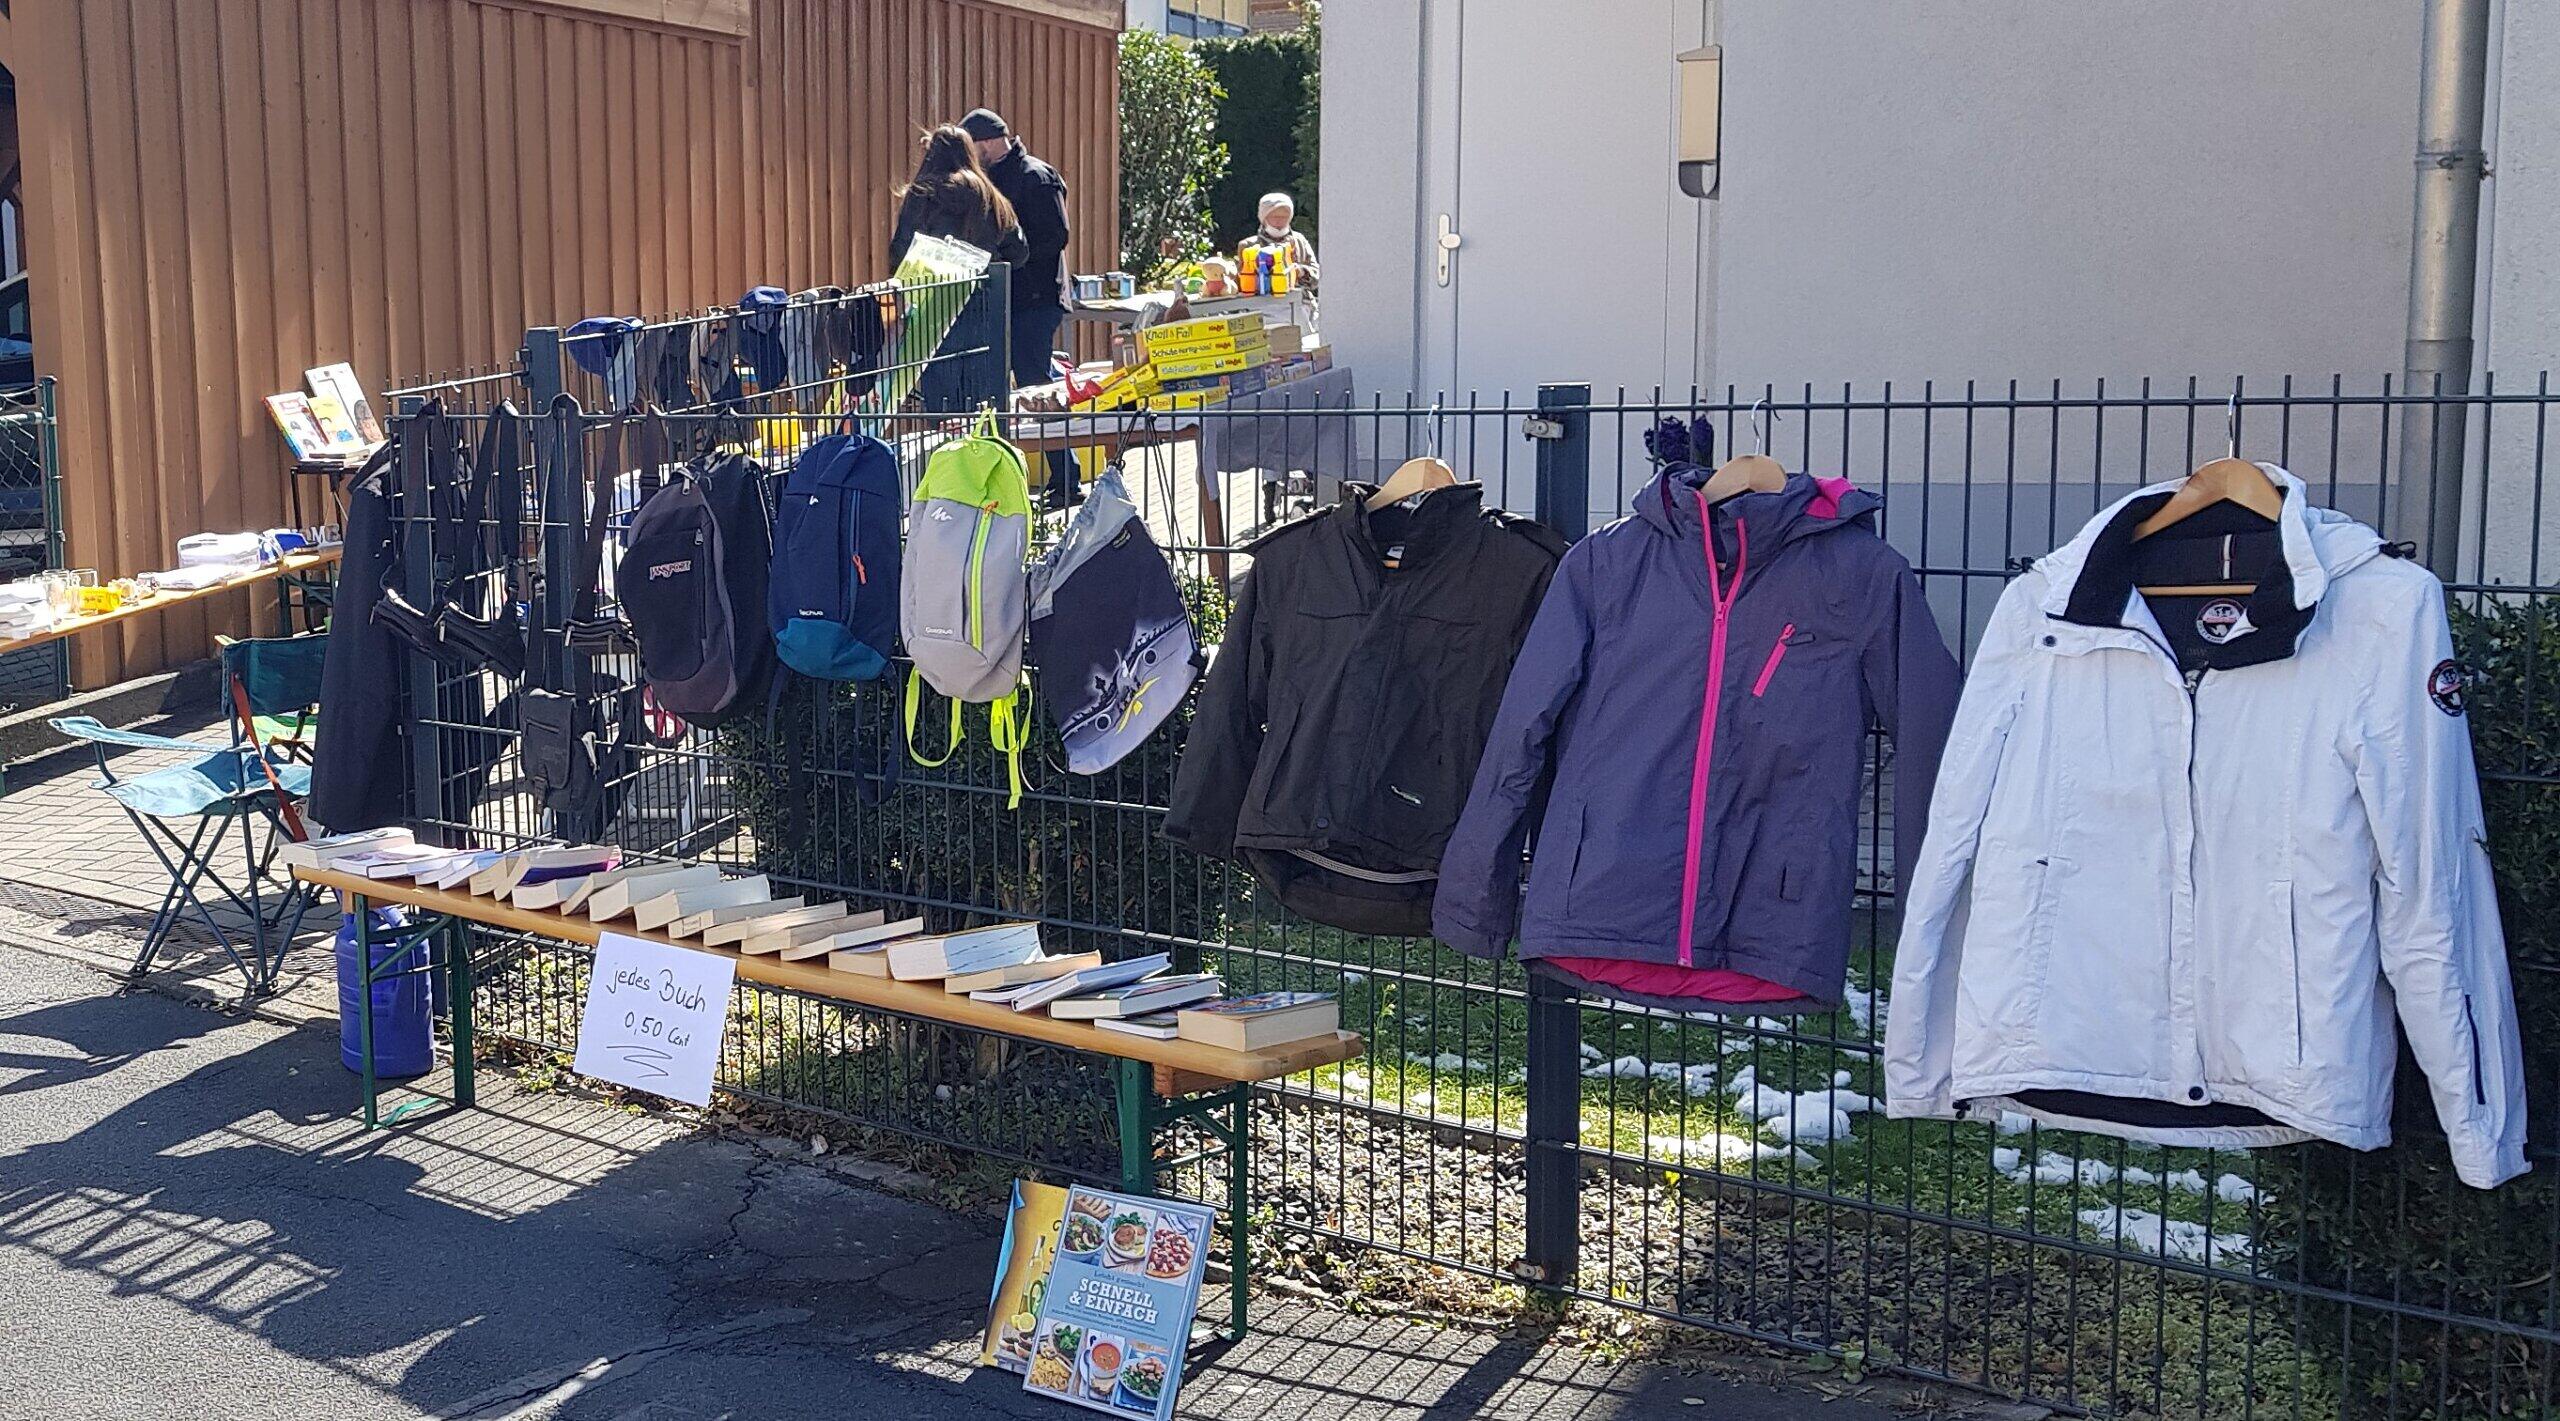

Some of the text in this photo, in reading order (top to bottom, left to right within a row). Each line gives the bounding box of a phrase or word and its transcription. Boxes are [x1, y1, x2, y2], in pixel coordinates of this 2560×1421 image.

[1176, 325, 1192, 339] Fall
[606, 963, 706, 1012] jedes Buch
[624, 1011, 690, 1047] 0,50 Cent
[1069, 1290, 1082, 1305] &
[1085, 1293, 1158, 1324] EINFACH
[1080, 1278, 1153, 1308] SCHNELL
